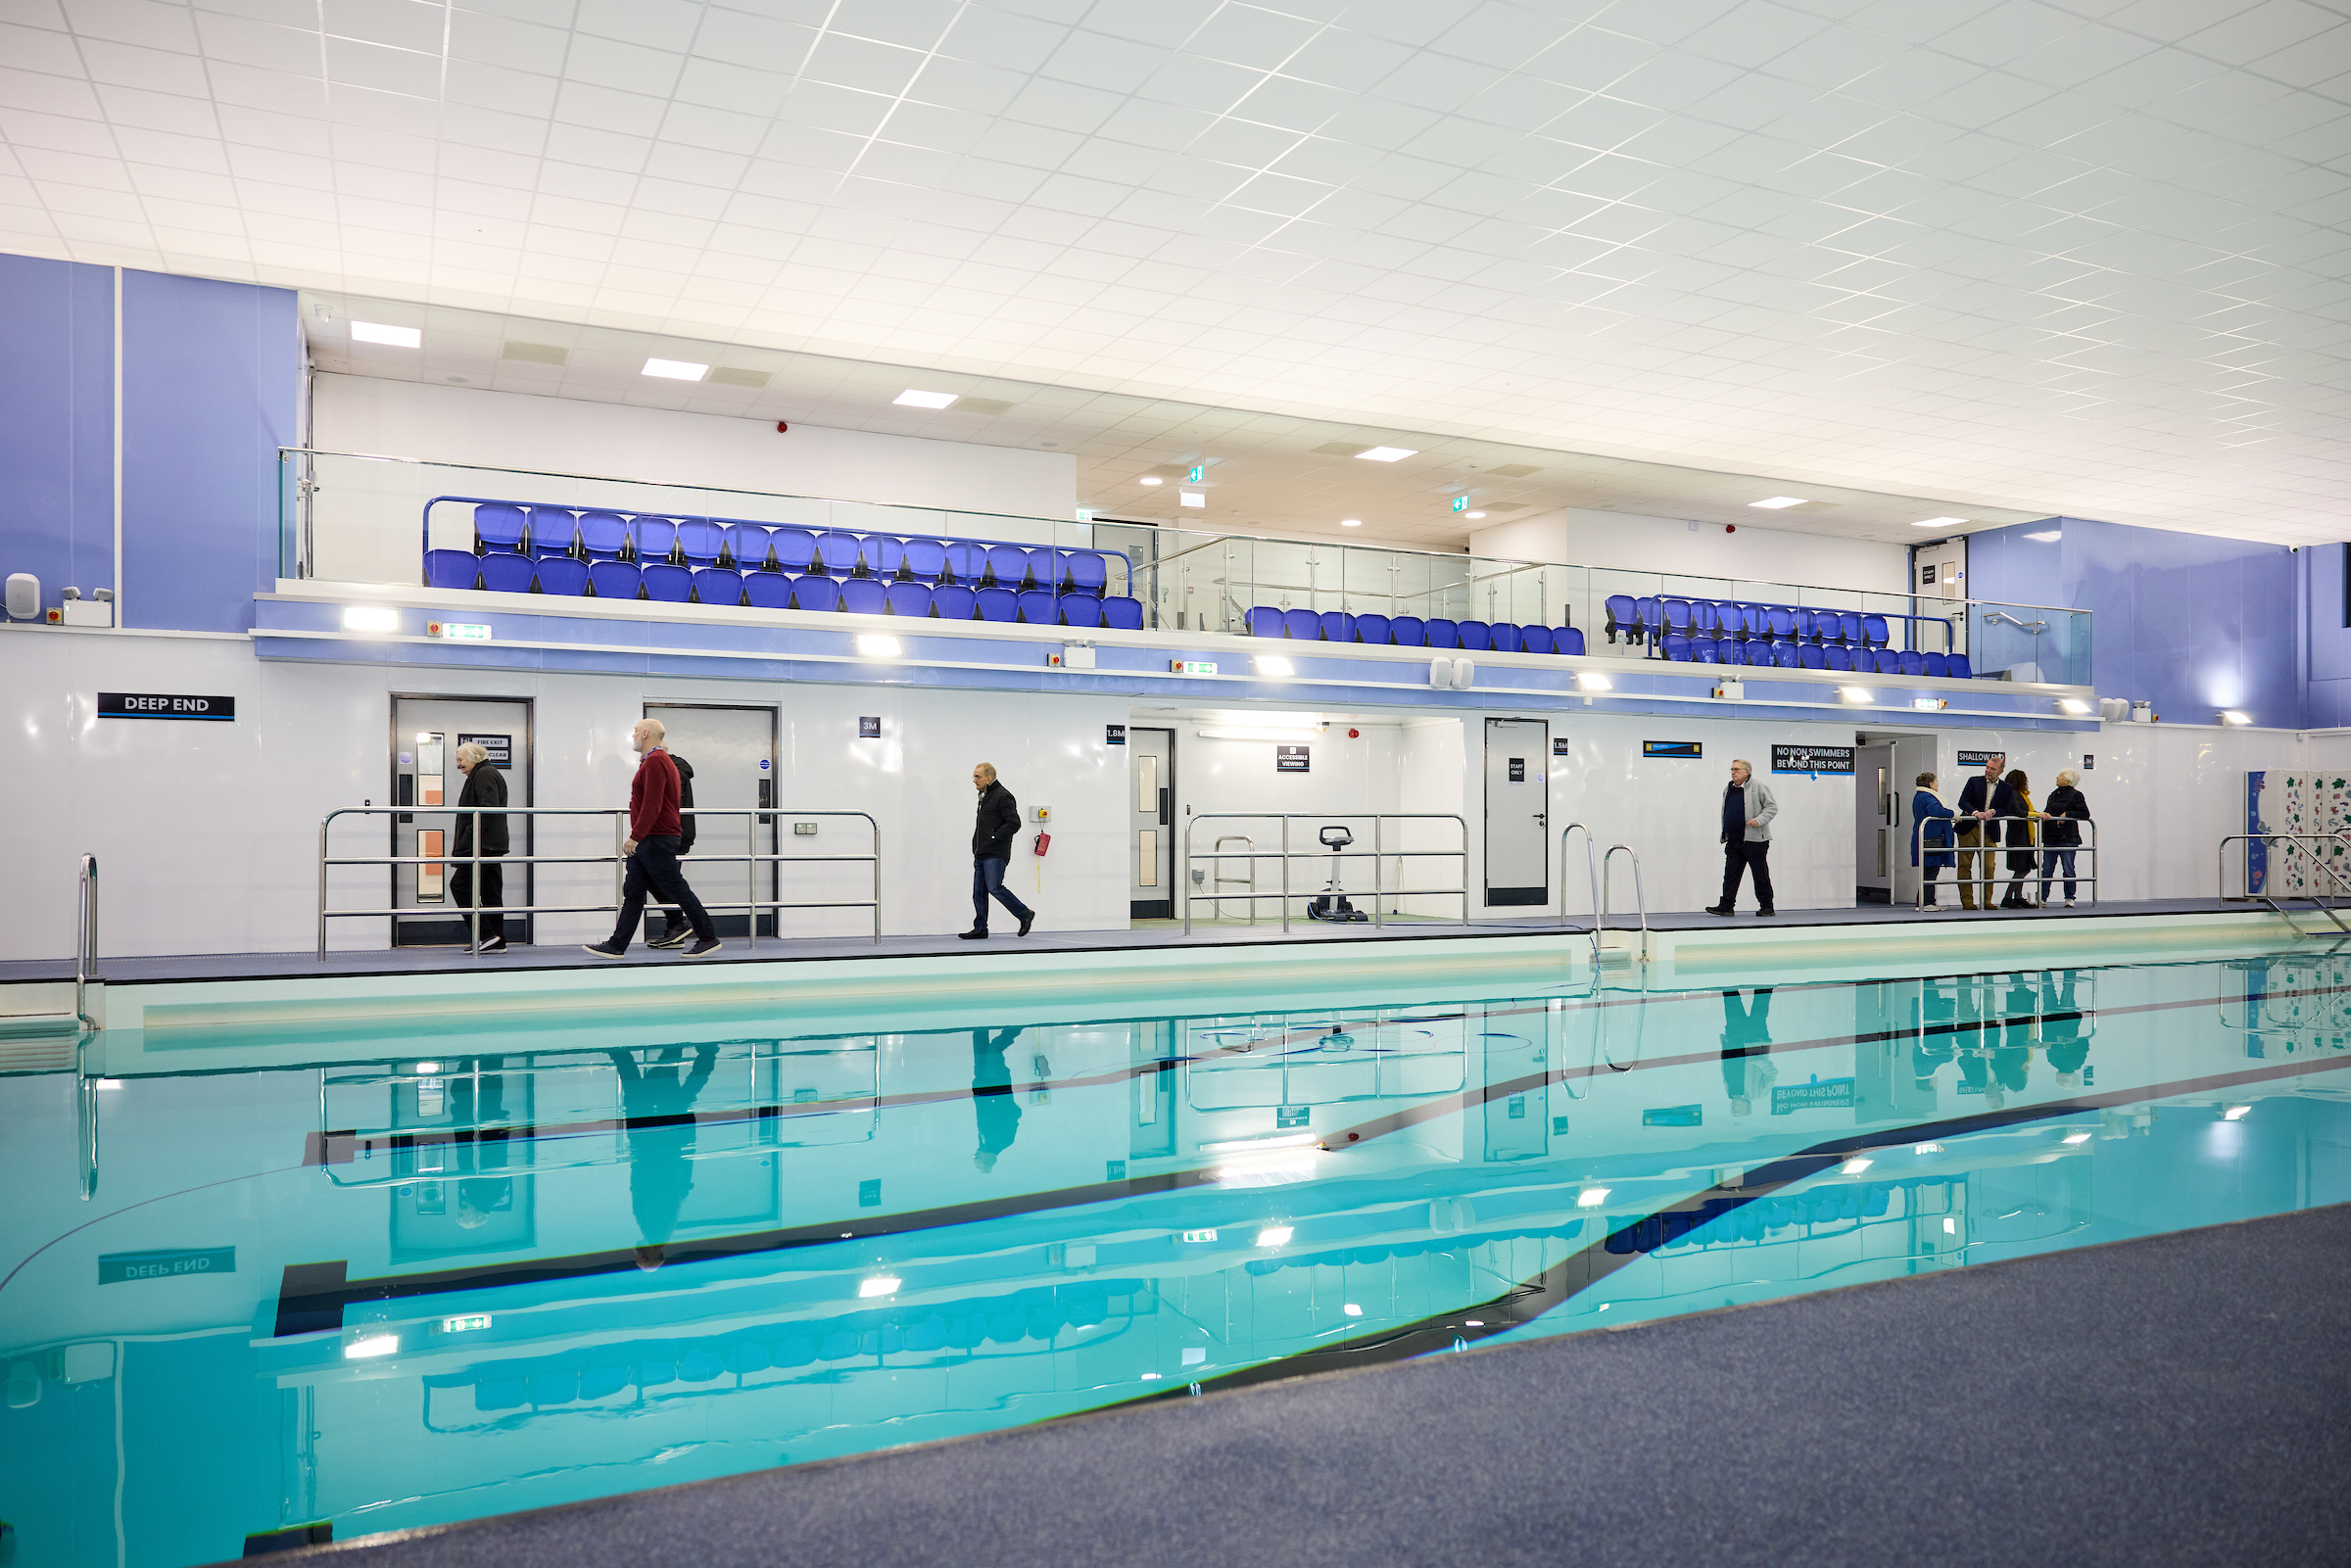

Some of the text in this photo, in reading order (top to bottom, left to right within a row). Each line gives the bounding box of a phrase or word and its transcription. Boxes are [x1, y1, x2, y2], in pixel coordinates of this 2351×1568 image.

[124, 696, 210, 712] DEEP END
[863, 722, 877, 731] 3M
[1107, 729, 1126, 737] 1.8M
[1776, 747, 1850, 758] NO NON SWIMMERS
[1959, 752, 1991, 761] SHALLOW
[1776, 760, 1850, 770] BEYOND THIS POINT
